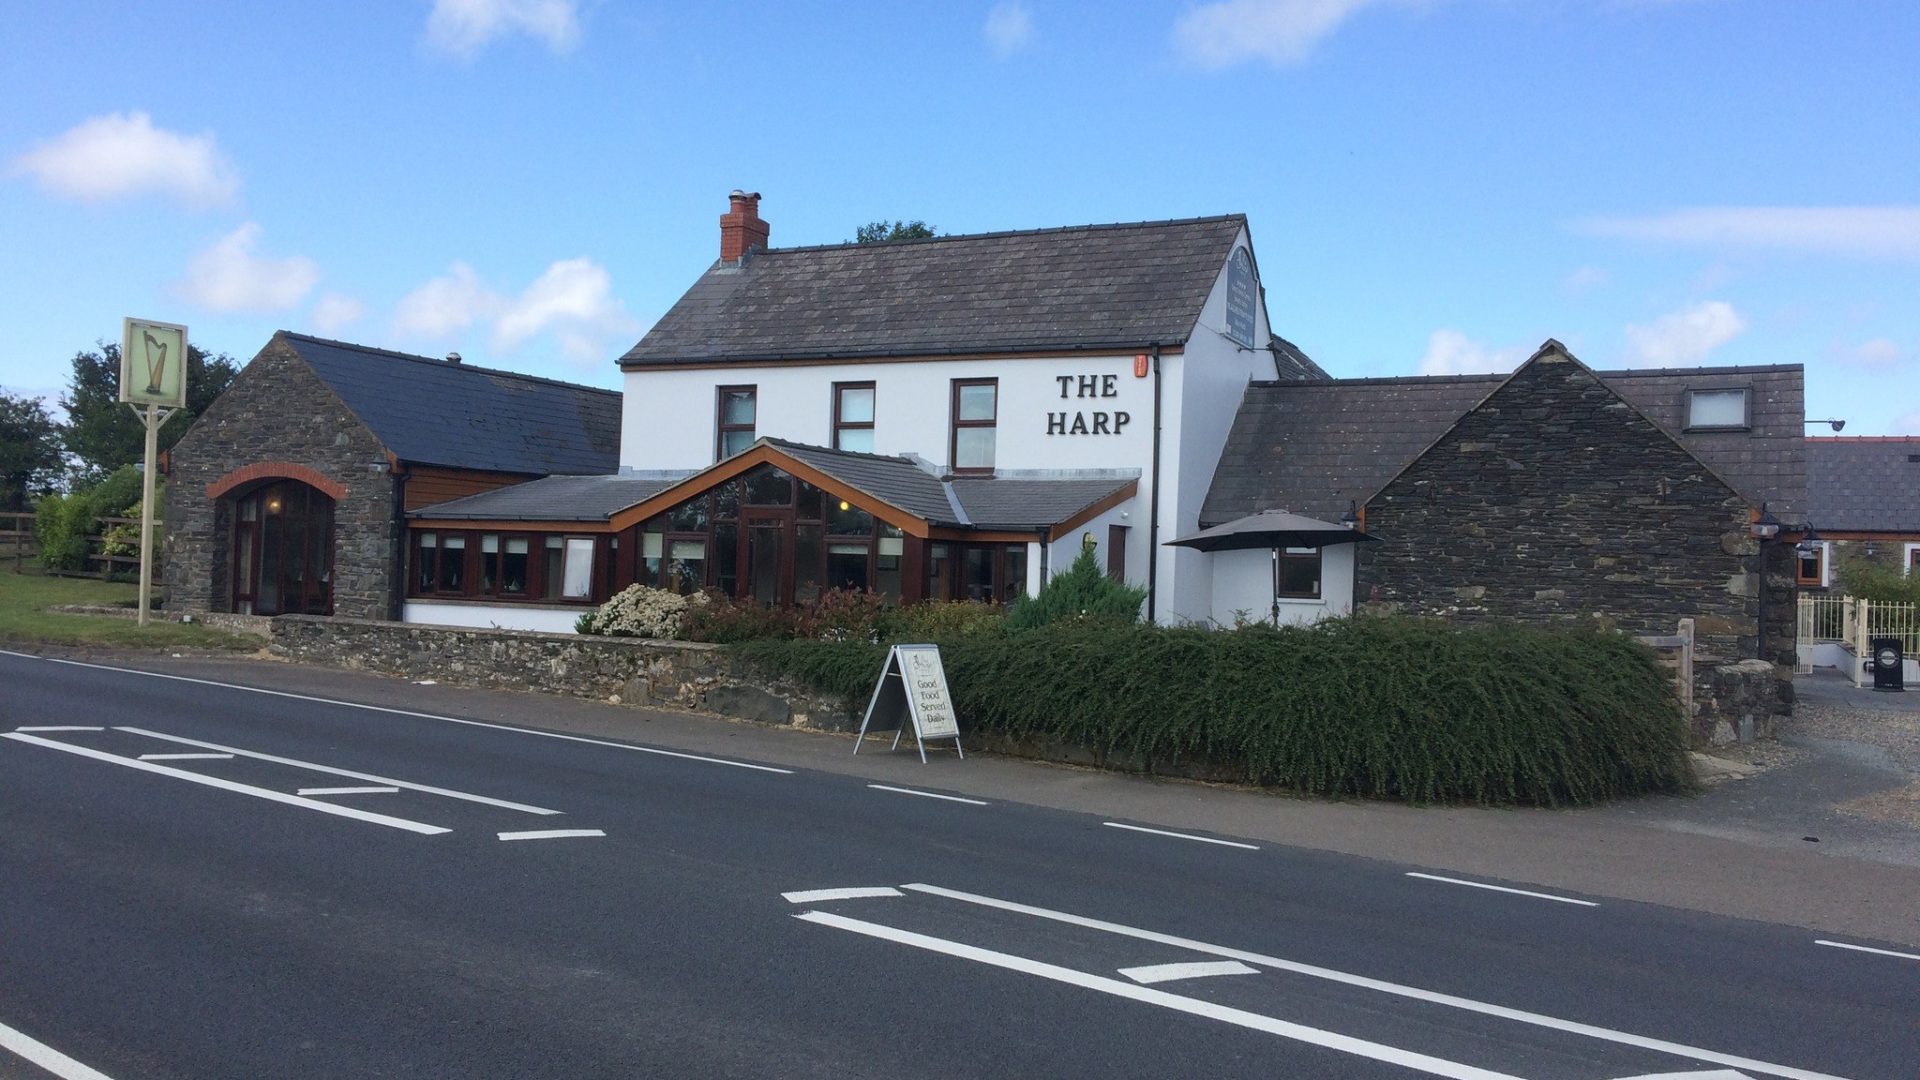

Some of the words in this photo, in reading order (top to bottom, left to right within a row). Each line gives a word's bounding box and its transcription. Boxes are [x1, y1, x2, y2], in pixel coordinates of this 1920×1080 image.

[1056, 374, 1118, 398] THE
[1046, 411, 1131, 435] HARP
[917, 679, 937, 689] Good
[920, 690, 940, 700] Food
[920, 701, 946, 711] Served
